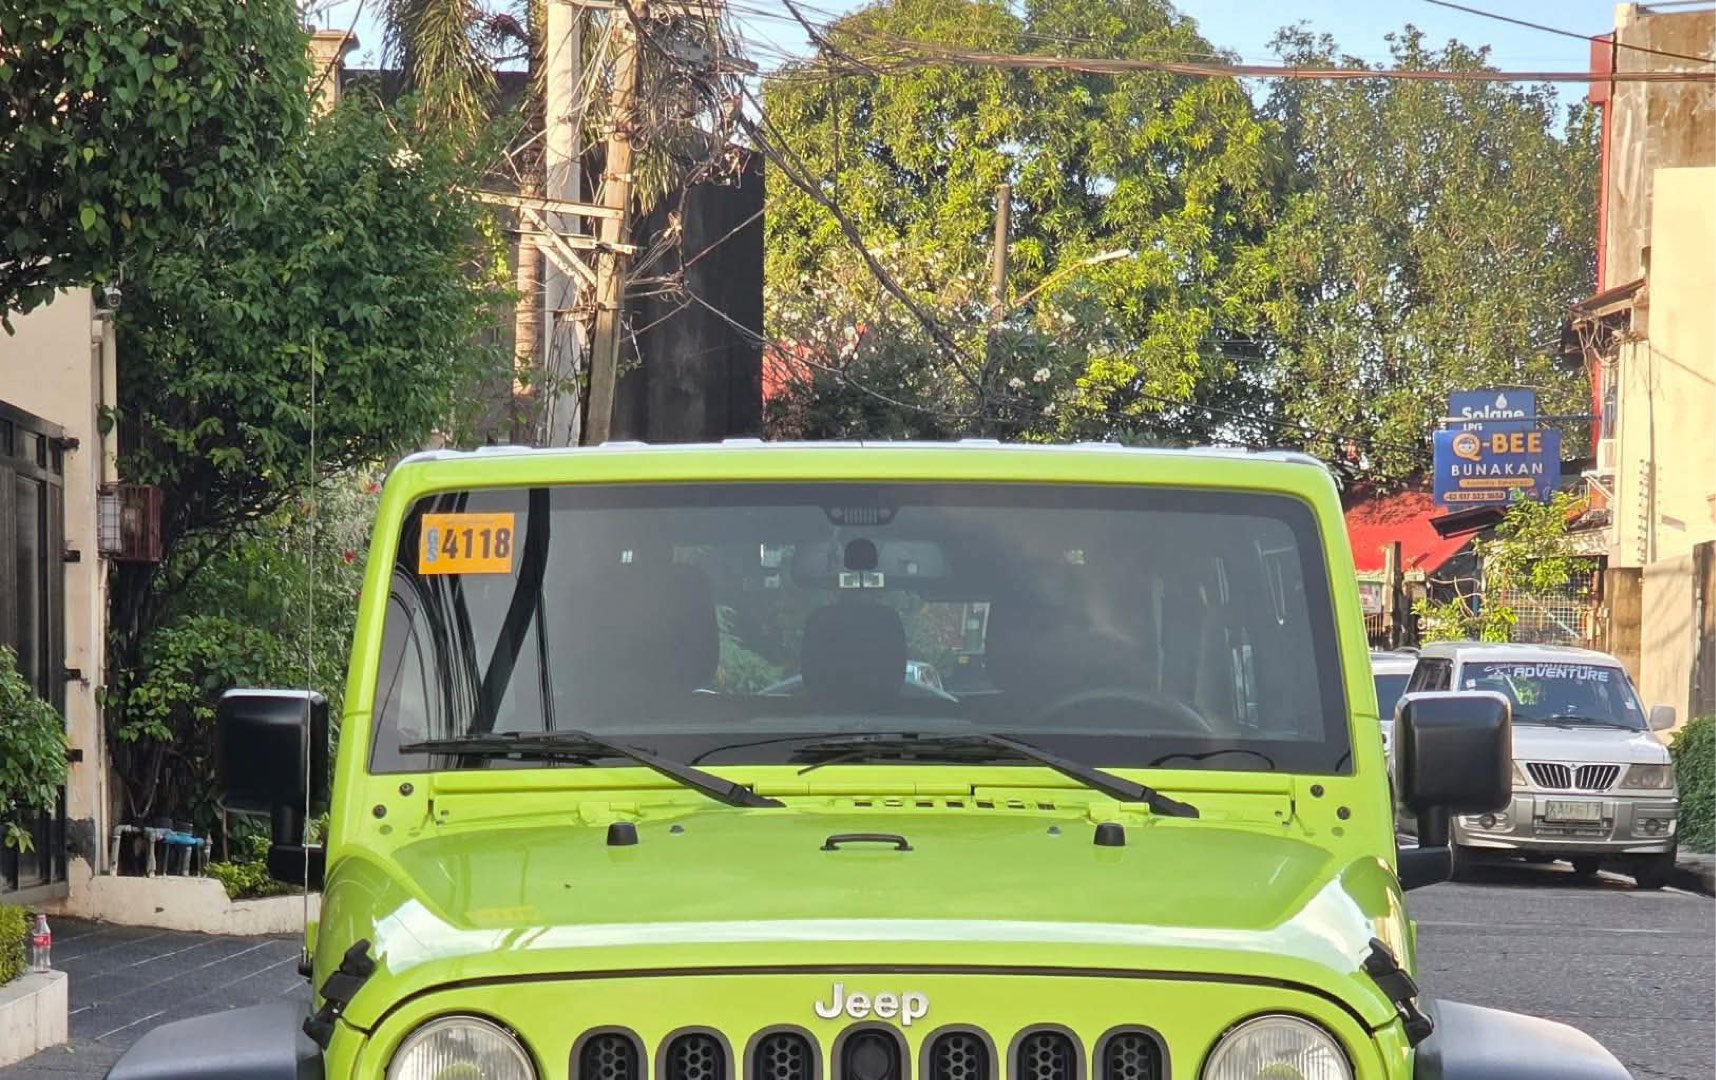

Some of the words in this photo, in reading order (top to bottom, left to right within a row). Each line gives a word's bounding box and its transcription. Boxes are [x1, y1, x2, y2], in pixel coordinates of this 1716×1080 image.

[1452, 432, 1543, 461] Q-BEE
[1451, 462, 1543, 477] BUNAKAN
[442, 527, 511, 559] 4118
[1513, 666, 1610, 682] ADVENTURE
[815, 983, 929, 1026] Jeep
